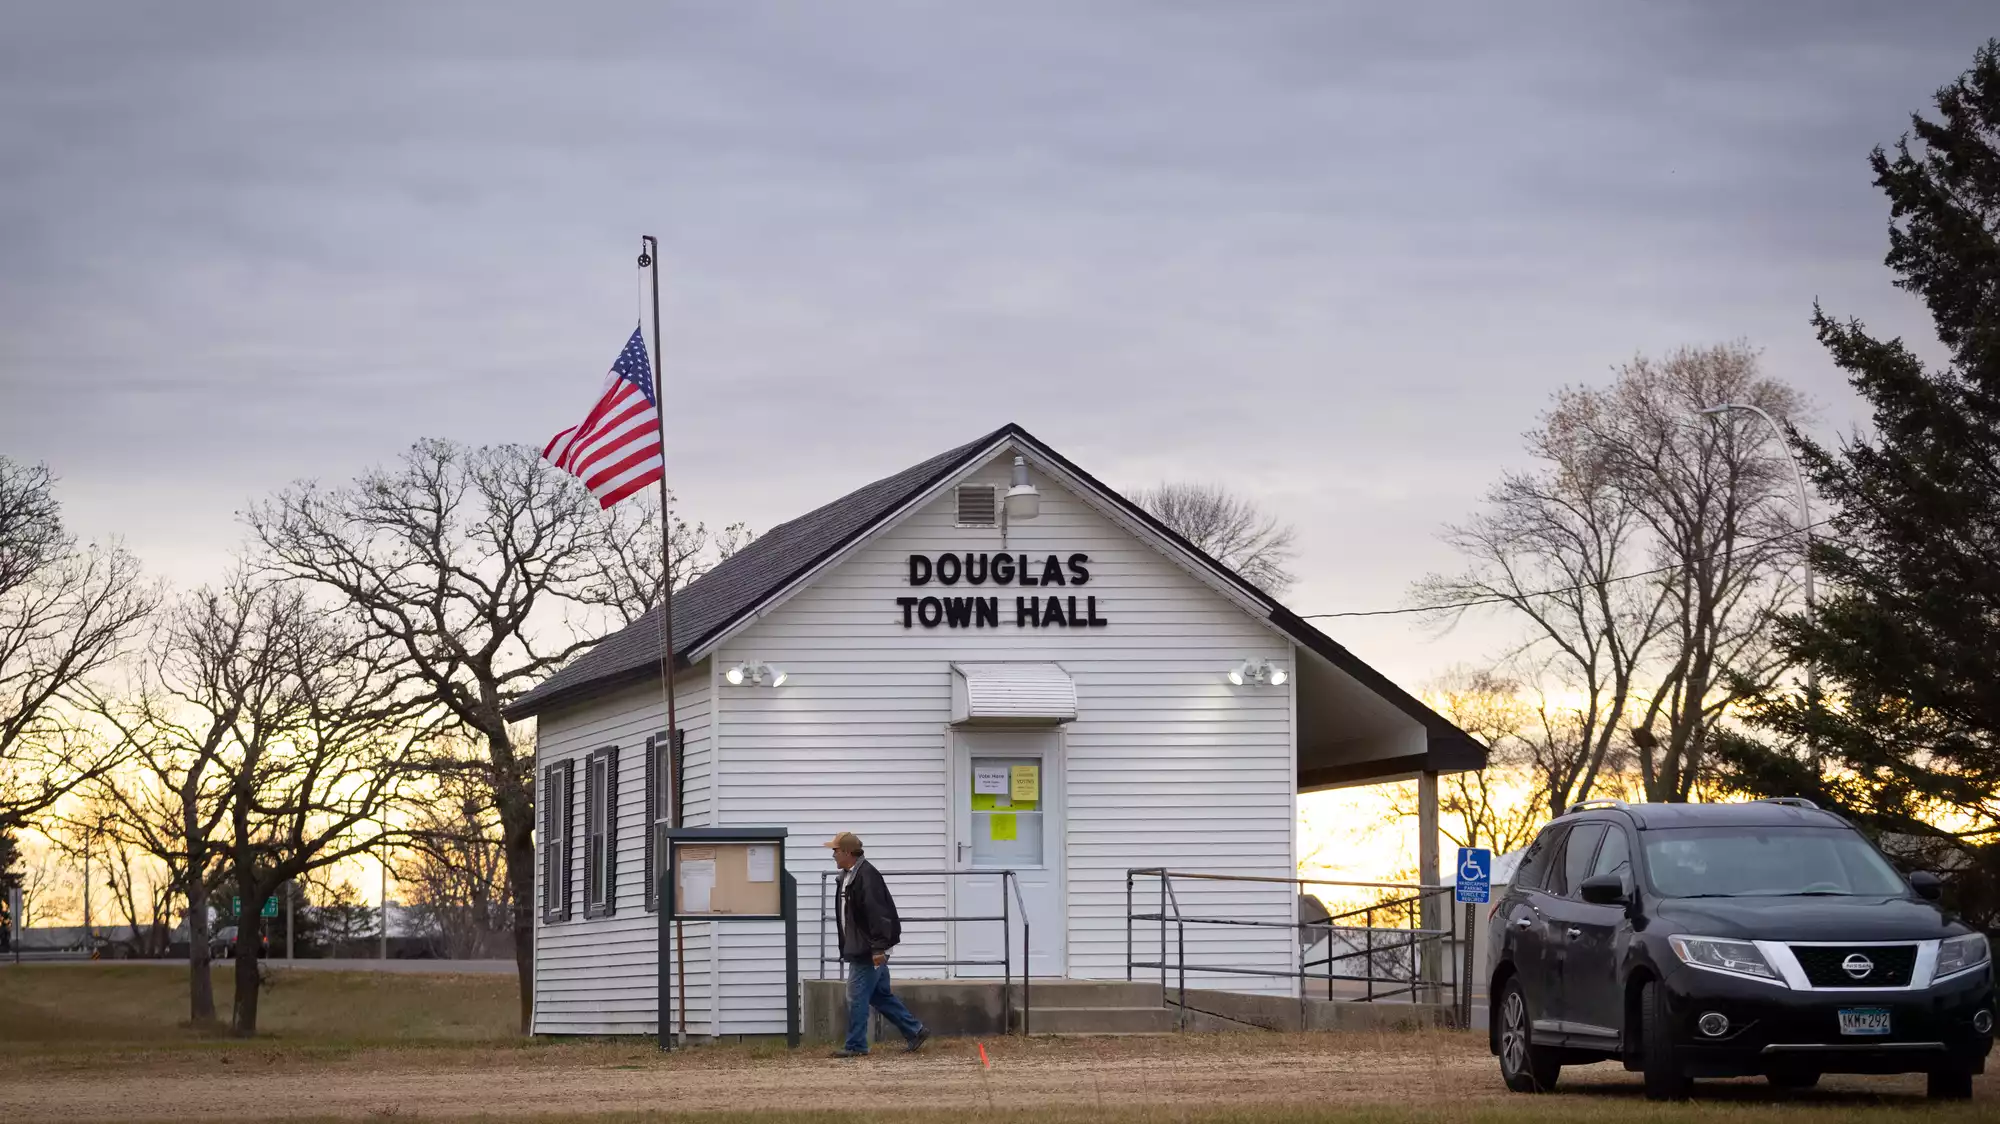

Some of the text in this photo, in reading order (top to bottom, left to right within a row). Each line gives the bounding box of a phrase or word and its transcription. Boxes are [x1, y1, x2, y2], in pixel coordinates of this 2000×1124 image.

[909, 552, 1090, 586] DOUGLAS
[896, 596, 1108, 628] TOWN HALL
